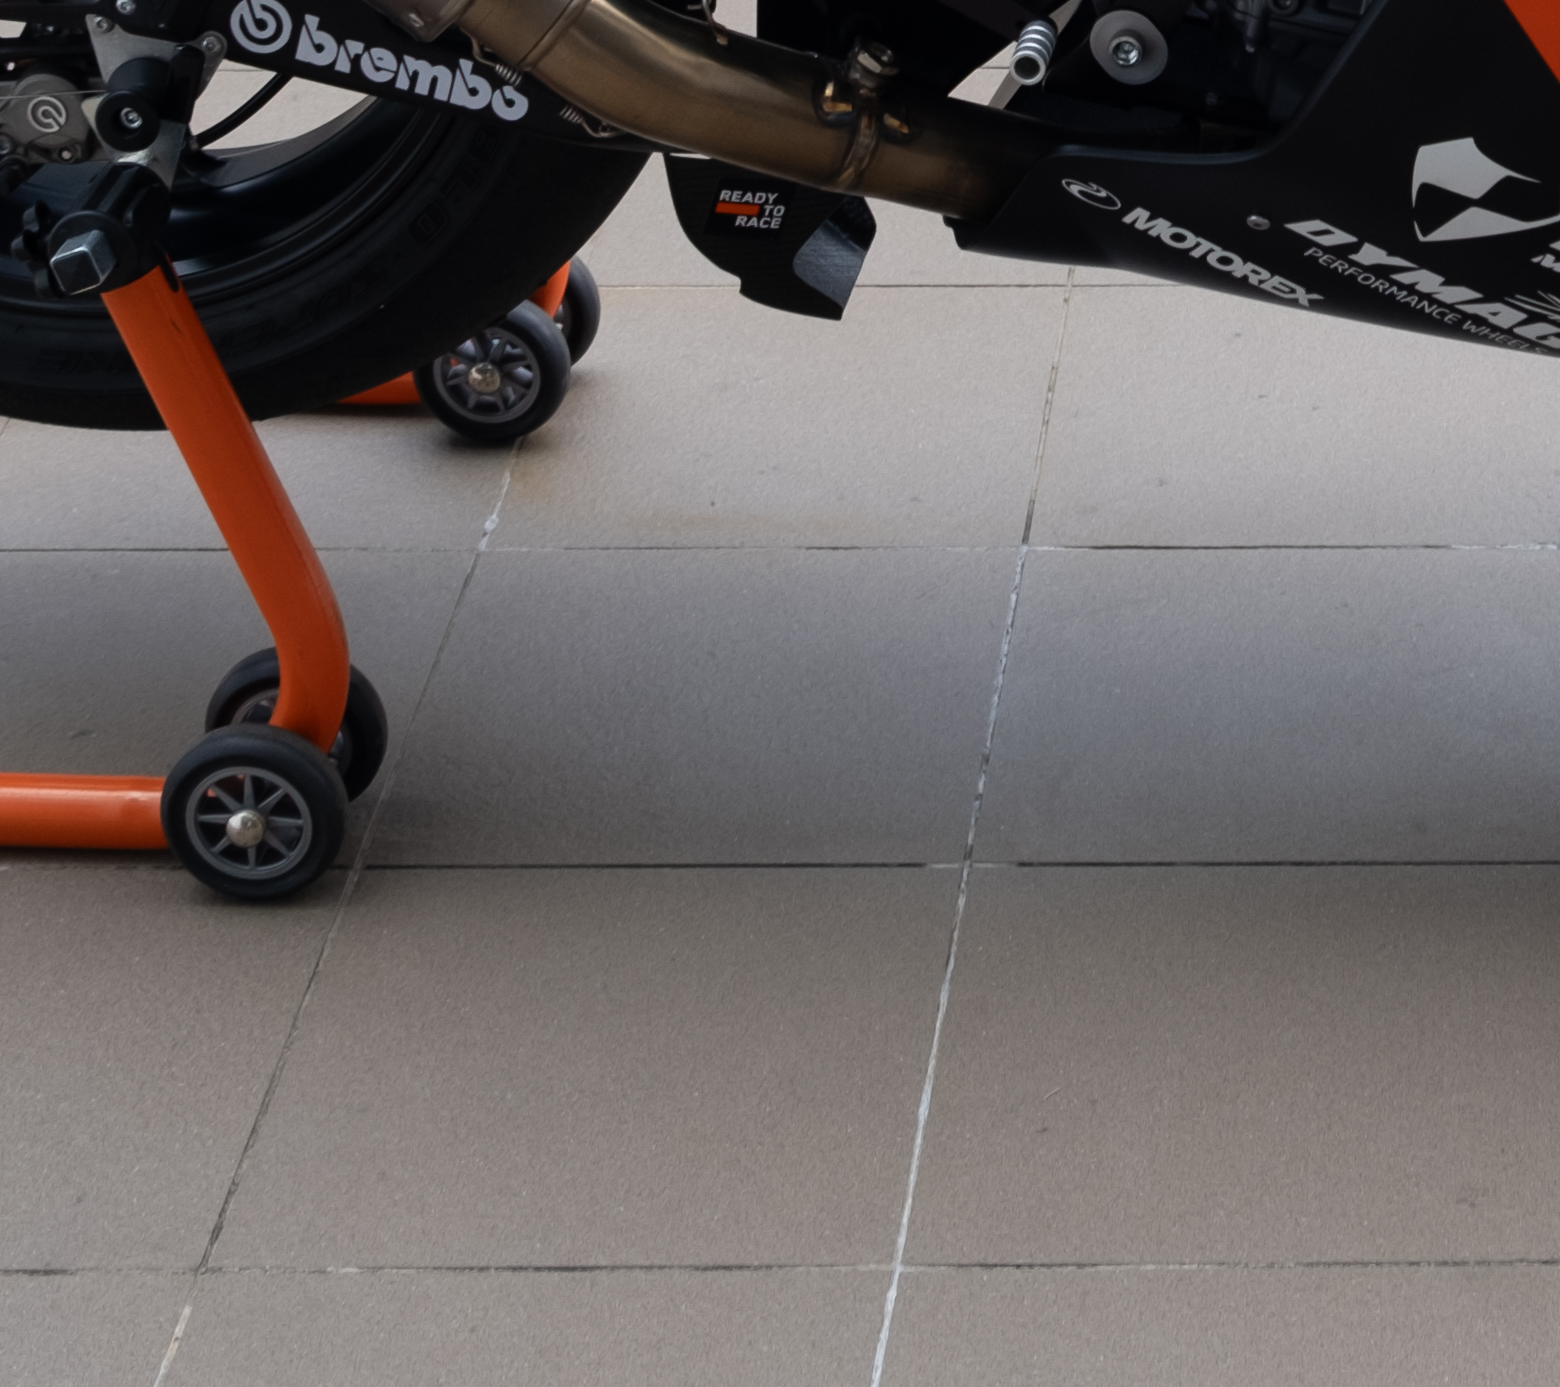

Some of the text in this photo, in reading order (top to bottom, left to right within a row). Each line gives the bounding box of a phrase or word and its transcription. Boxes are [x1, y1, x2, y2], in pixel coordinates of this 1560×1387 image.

[294, 13, 530, 122] brembo
[719, 189, 779, 204] READY
[763, 204, 787, 217] TO
[734, 215, 782, 229] RACE
[1122, 206, 1324, 308] MOTOREX
[1304, 245, 1463, 326] PERFORMANCE
